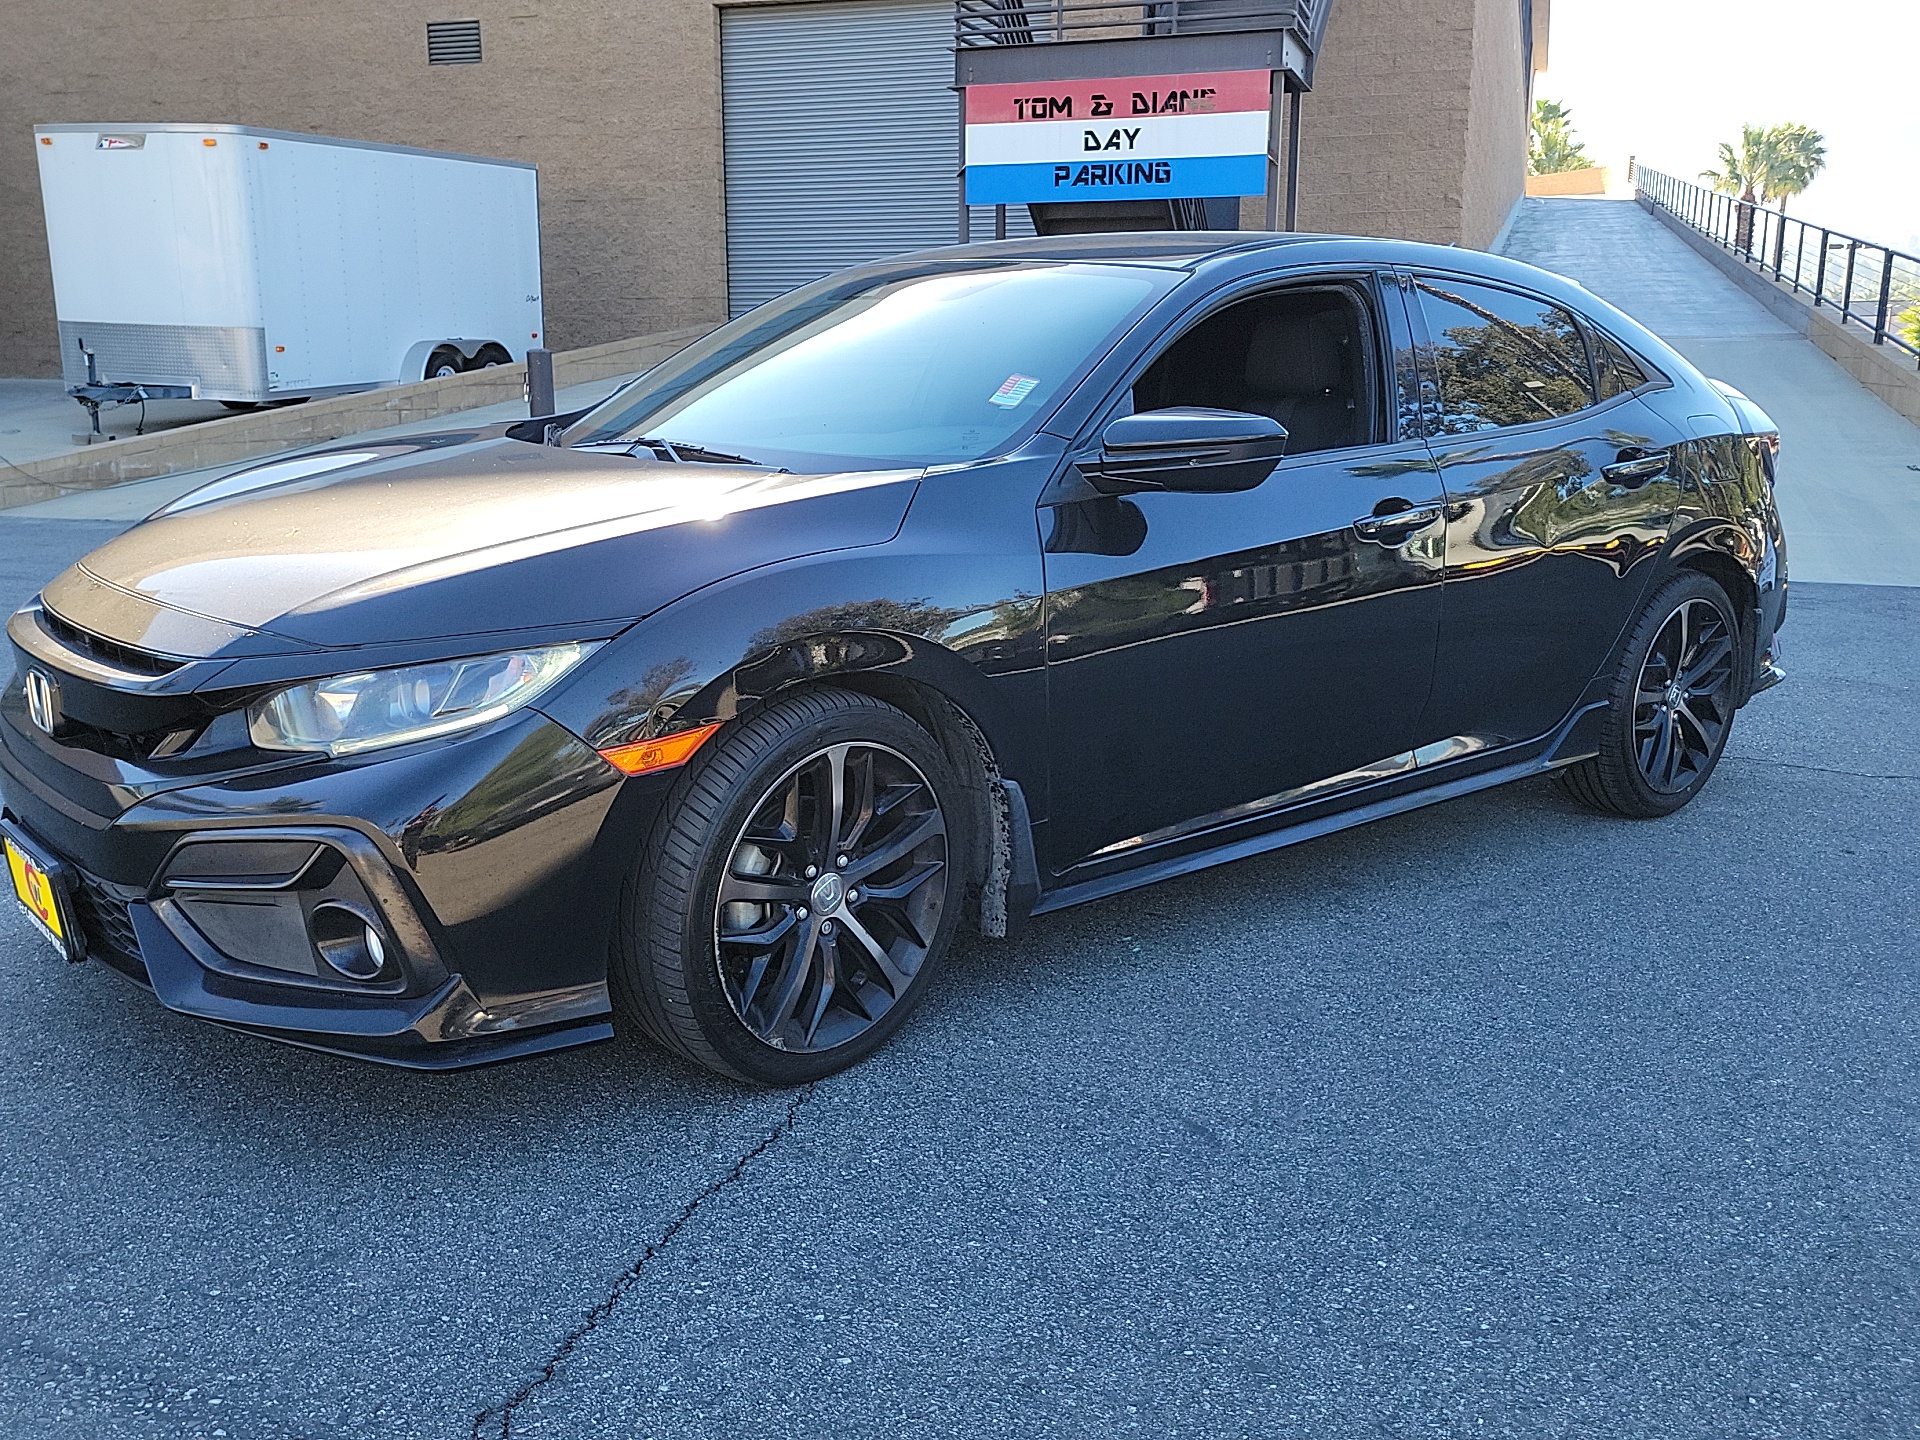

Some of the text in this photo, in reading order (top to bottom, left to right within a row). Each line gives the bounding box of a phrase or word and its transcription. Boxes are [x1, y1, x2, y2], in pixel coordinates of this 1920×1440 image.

[1013, 96, 1073, 119] TOM
[1090, 94, 1114, 116] &
[1083, 127, 1142, 151] DAY
[1054, 161, 1172, 187] PARKING
